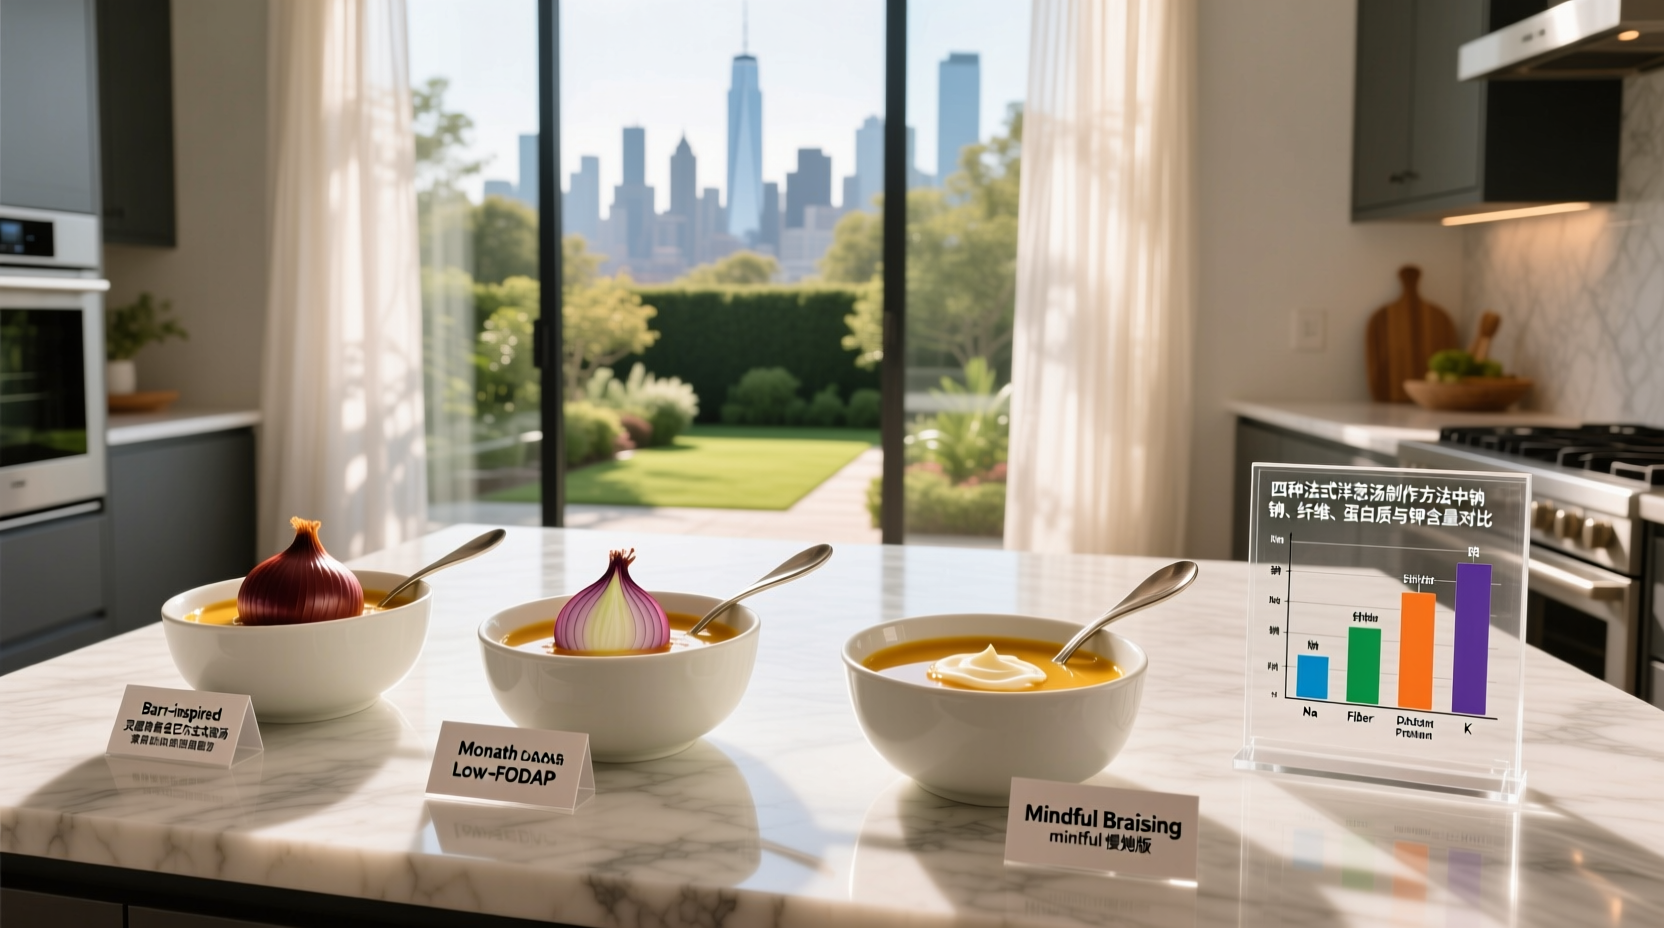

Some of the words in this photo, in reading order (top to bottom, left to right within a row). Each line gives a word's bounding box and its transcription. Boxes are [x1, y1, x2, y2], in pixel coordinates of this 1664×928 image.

[1303, 706, 1318, 718] Na
[1464, 722, 1472, 735] K
[458, 740, 518, 761] Monath
[452, 761, 556, 786] Low-FODAP
[1025, 804, 1098, 828] Mindful
[1103, 811, 1182, 840] Braising
